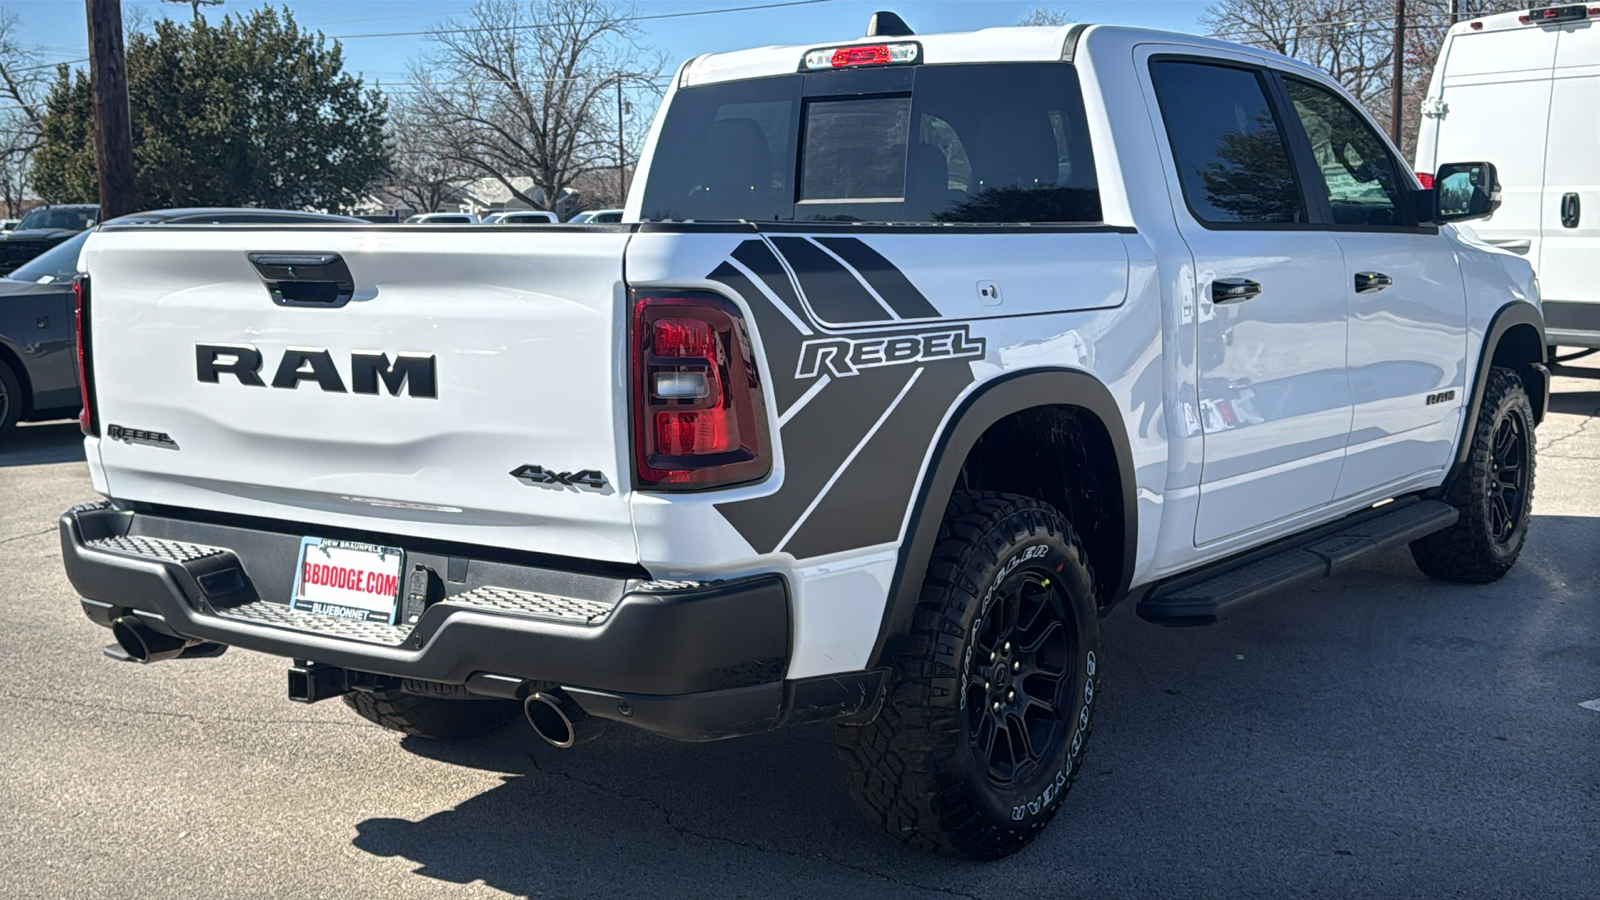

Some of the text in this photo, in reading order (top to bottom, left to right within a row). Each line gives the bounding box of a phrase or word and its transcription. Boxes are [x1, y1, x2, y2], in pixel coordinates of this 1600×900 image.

[195, 342, 439, 400] RAM
[794, 329, 987, 379] REBEL
[1426, 390, 1455, 406] RAM
[107, 423, 177, 449] REBEL
[322, 539, 338, 547] NEW
[339, 541, 382, 553] BRAUNFELS
[303, 562, 398, 597] BBDODGE.COM
[312, 603, 370, 621] BLUEBONNET
[960, 544, 1049, 711] WRANGLER
[1011, 650, 1096, 821] GOODYEAR
